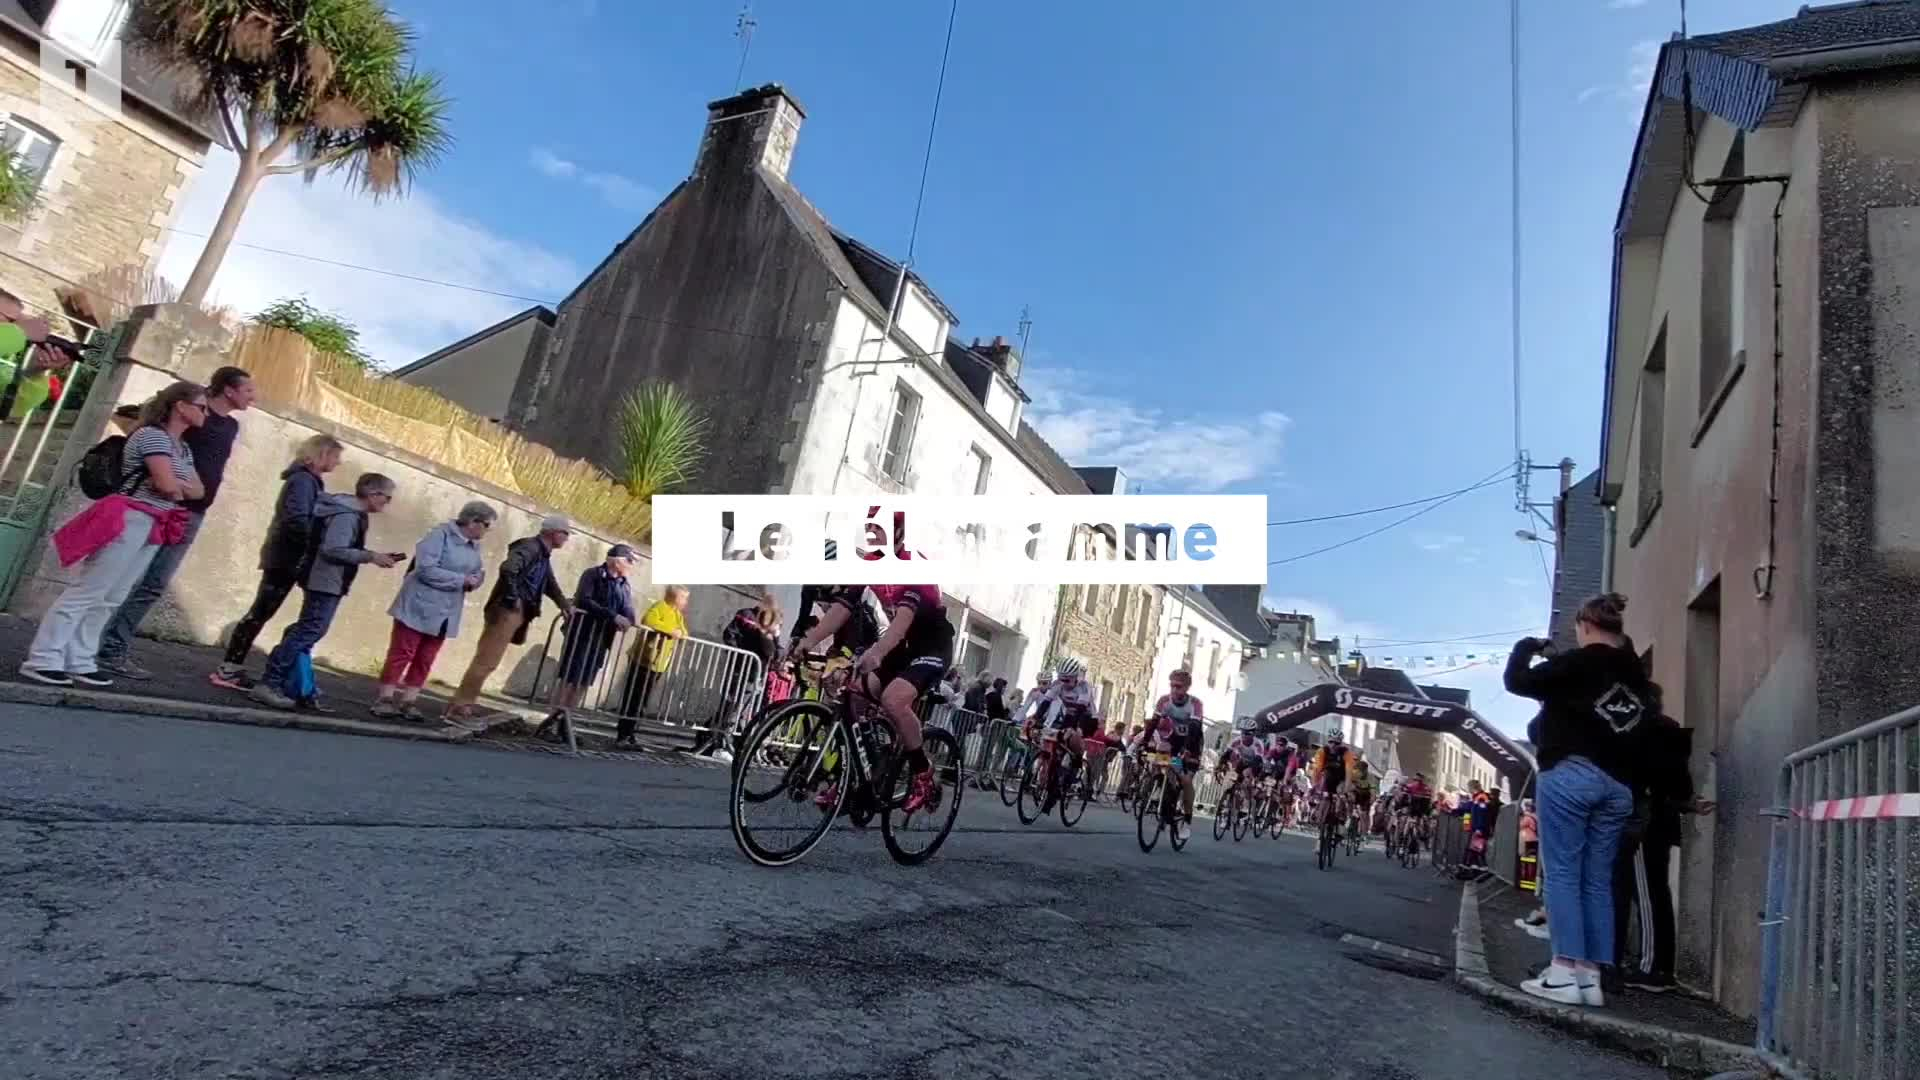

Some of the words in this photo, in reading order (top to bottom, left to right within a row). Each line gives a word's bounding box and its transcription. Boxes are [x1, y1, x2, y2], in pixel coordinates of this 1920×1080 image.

[1277, 695, 1319, 718] SCOTT
[1353, 696, 1452, 718] SCOTT
[1472, 727, 1519, 761] SCOTT
